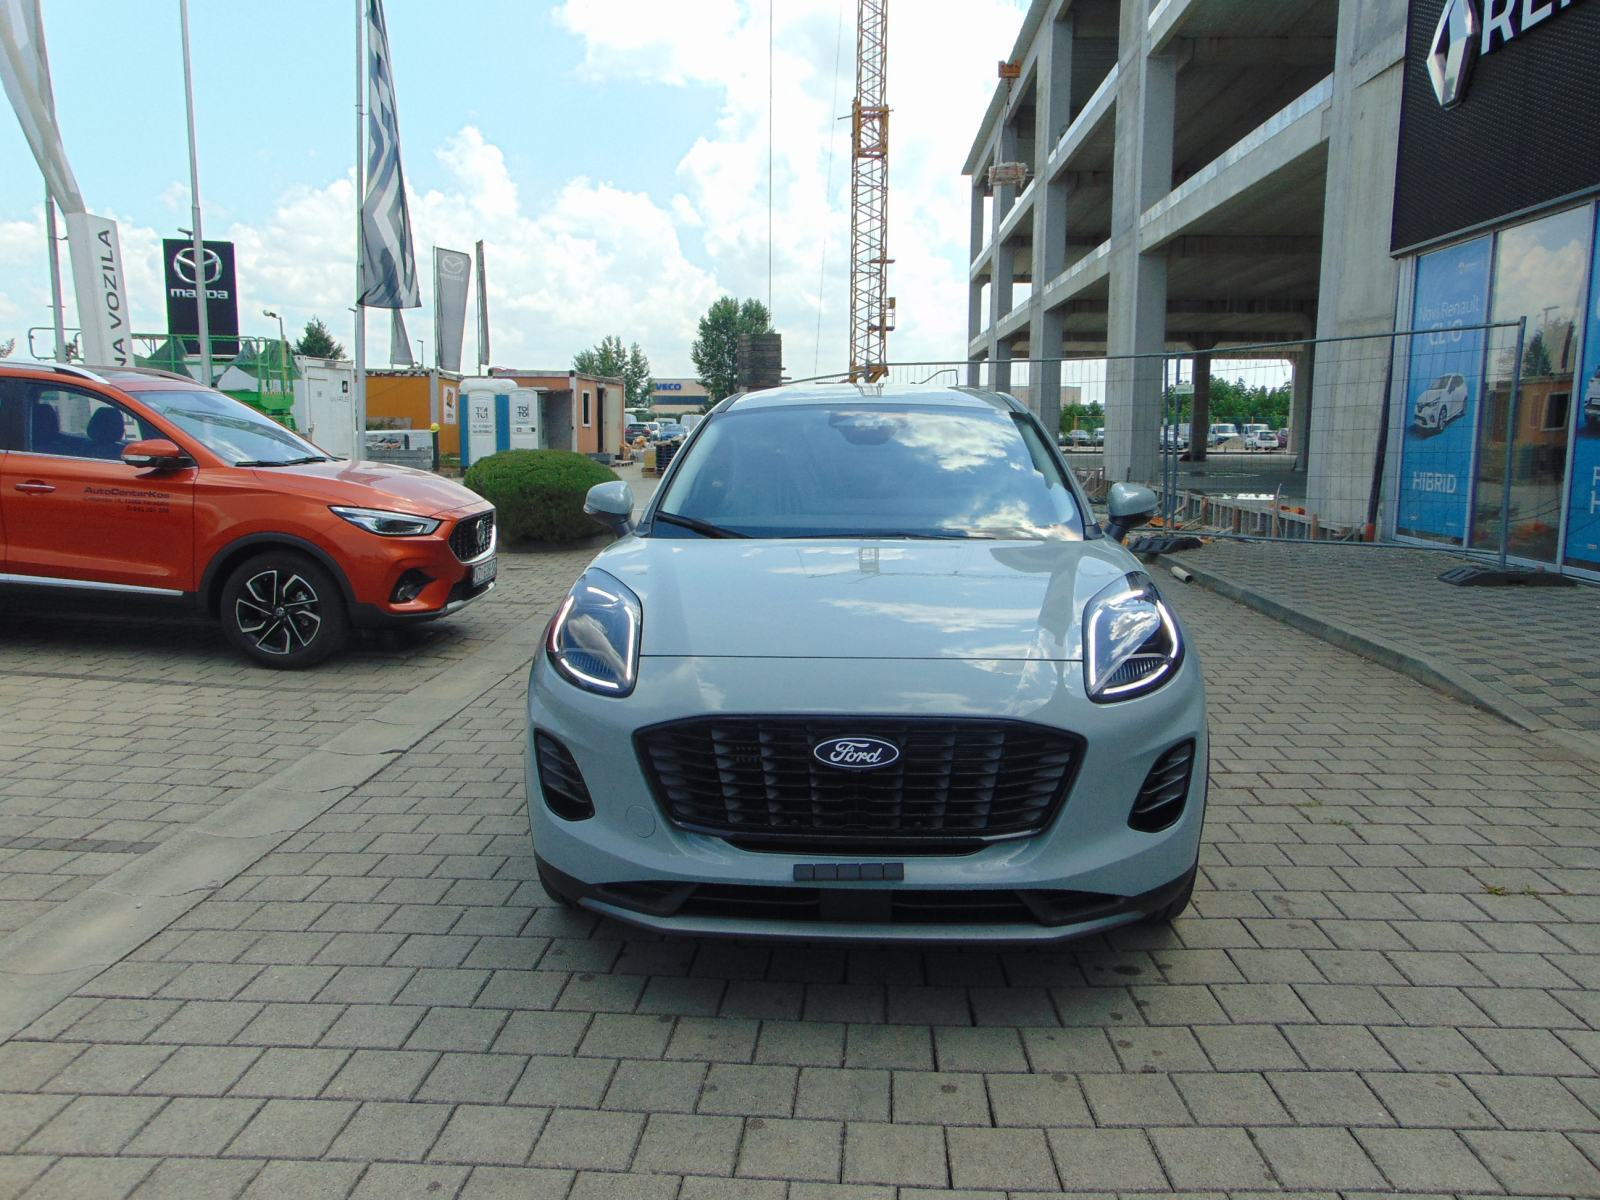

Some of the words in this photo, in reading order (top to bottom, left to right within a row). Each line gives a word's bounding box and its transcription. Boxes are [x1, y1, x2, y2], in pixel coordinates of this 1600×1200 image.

[97, 229, 122, 330] VOZILA
[170, 288, 229, 300] mada
[1412, 471, 1457, 494] HIBRID
[829, 741, 883, 763] Ford
